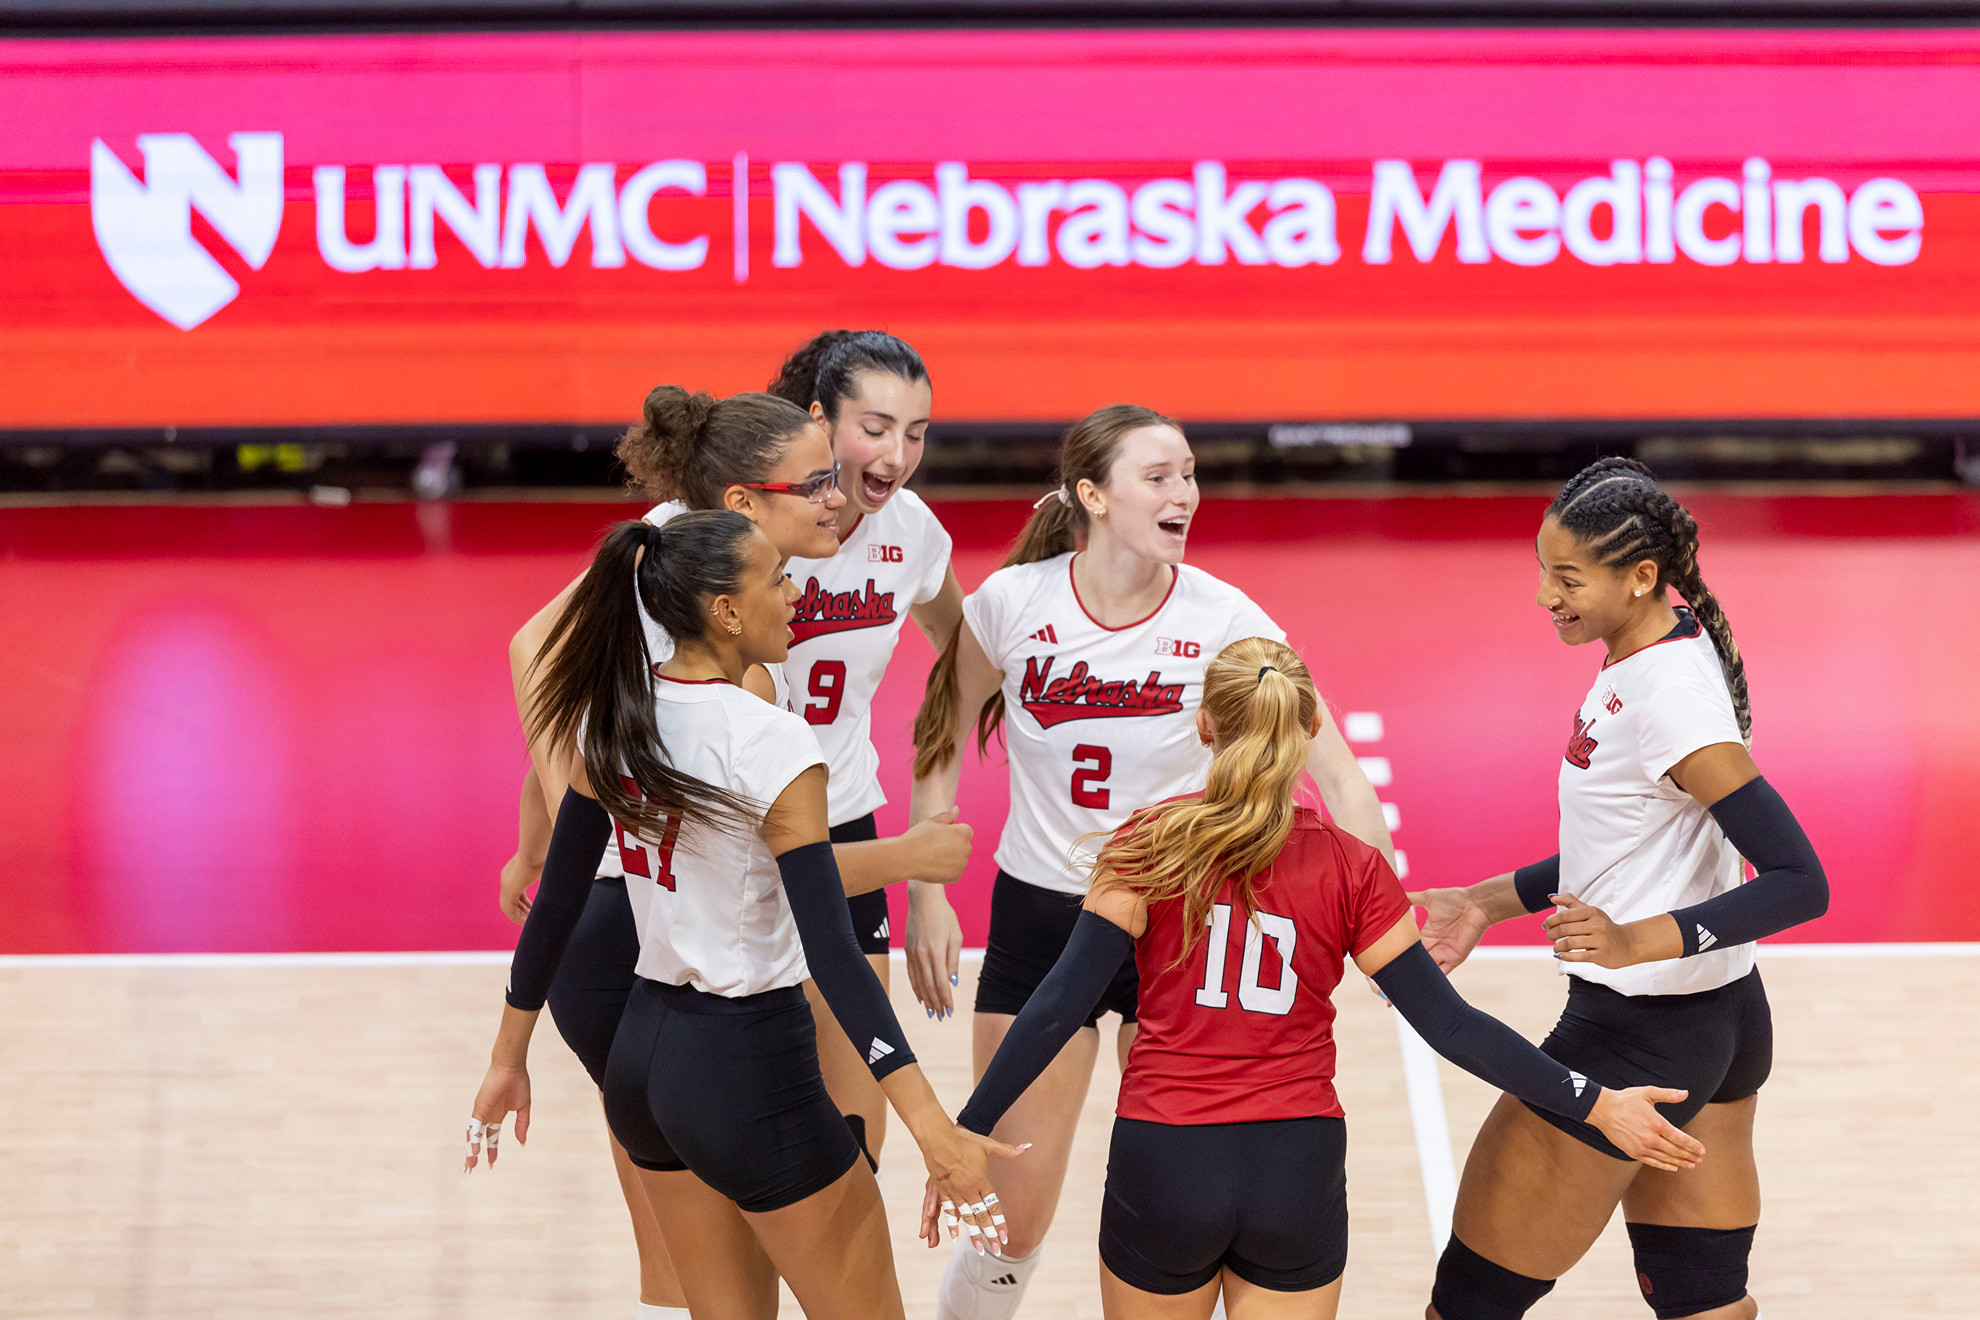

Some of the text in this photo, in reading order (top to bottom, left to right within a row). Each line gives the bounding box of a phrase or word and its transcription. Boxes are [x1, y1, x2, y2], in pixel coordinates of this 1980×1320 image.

[312, 159, 709, 273] UNMC
[771, 156, 1926, 269] Nebraska Medicine
[785, 575, 898, 624] ebraska
[804, 659, 847, 726] 9
[1019, 655, 1186, 710] Nebraska
[1070, 743, 1113, 810] 2
[1194, 903, 1298, 1016] 10
